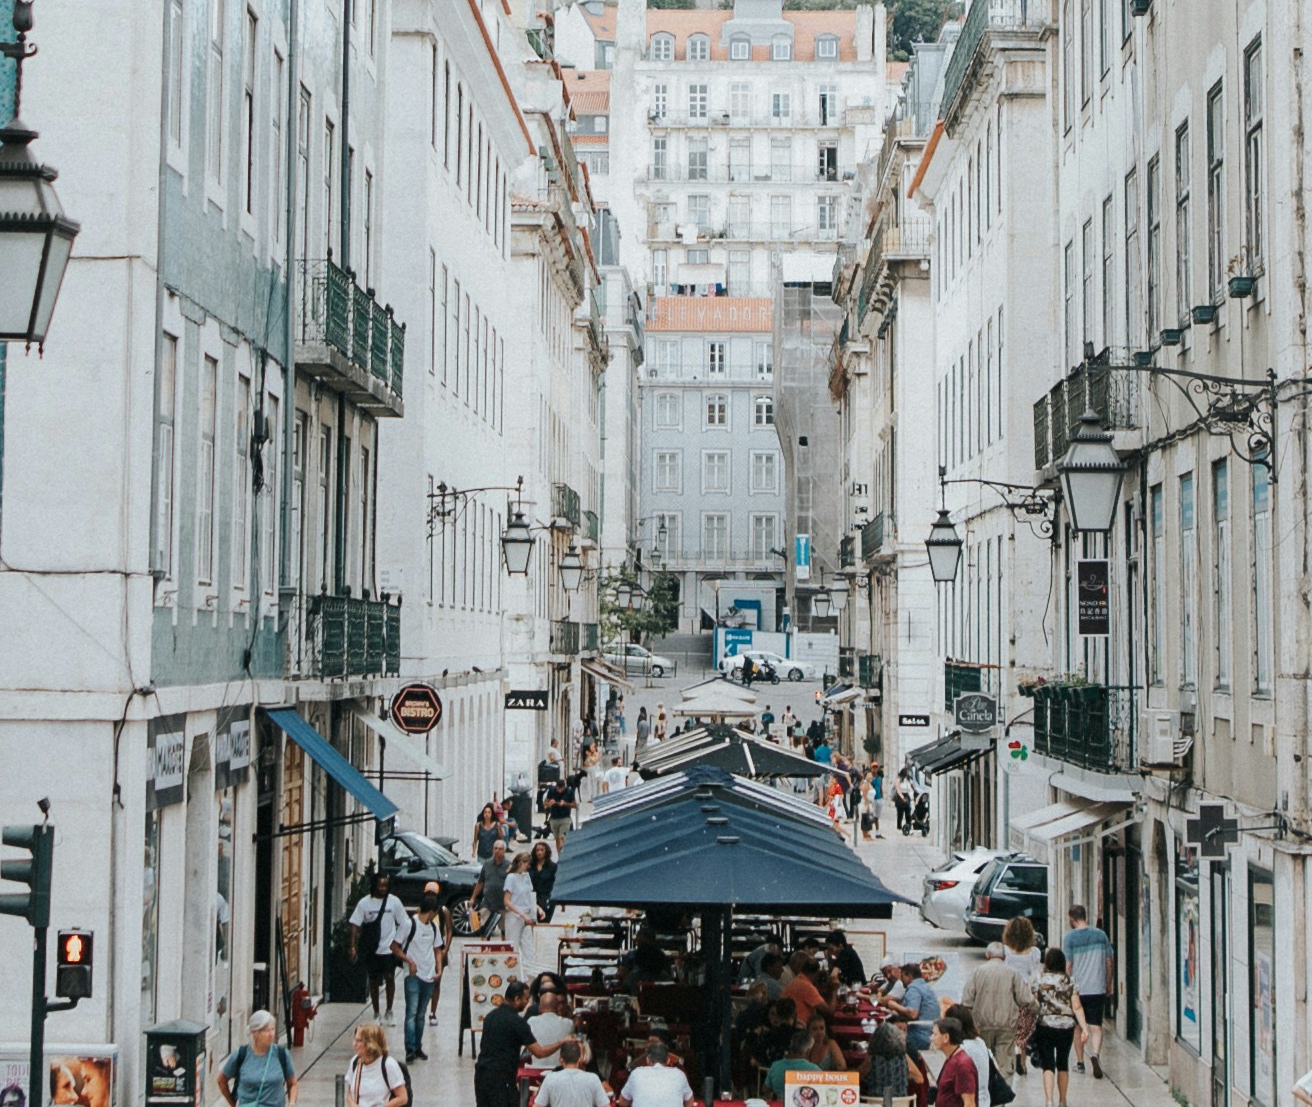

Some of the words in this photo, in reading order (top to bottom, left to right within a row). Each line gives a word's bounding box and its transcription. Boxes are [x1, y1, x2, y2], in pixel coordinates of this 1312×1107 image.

[507, 698, 545, 707] ZARA
[400, 706, 435, 718] BISTRO
[959, 709, 993, 721] Canela
